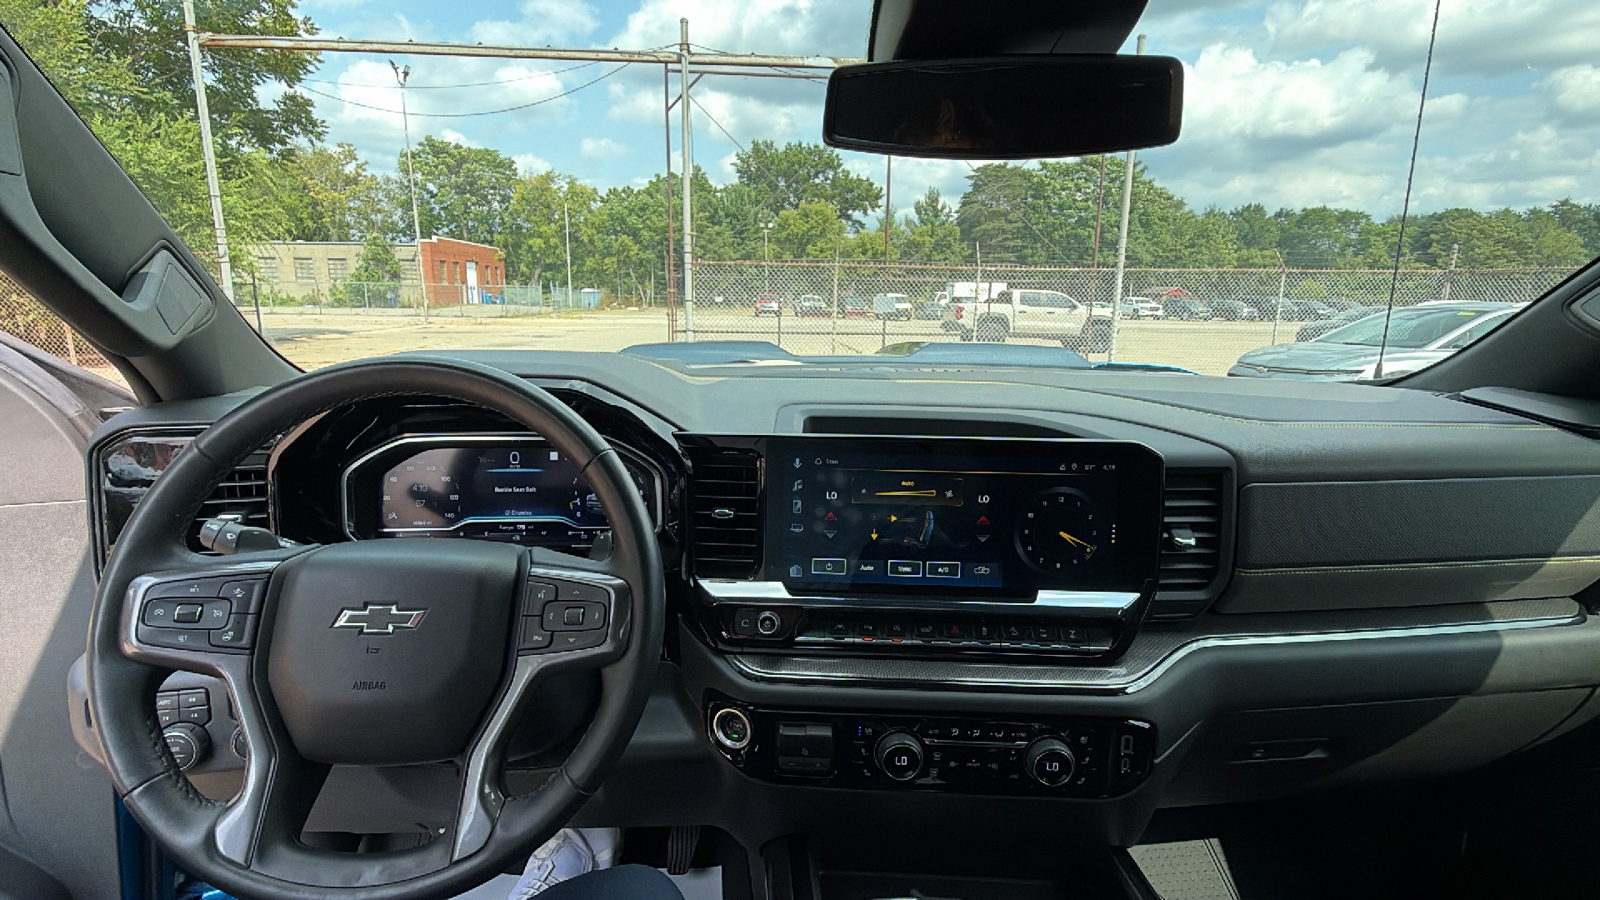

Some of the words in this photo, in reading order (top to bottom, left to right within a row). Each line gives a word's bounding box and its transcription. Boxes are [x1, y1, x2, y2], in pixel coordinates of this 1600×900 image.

[826, 491, 838, 500] LO
[978, 494, 990, 503] LO
[351, 681, 387, 691] AIRBAG
[895, 756, 908, 766] LO
[1046, 762, 1059, 772] LO
